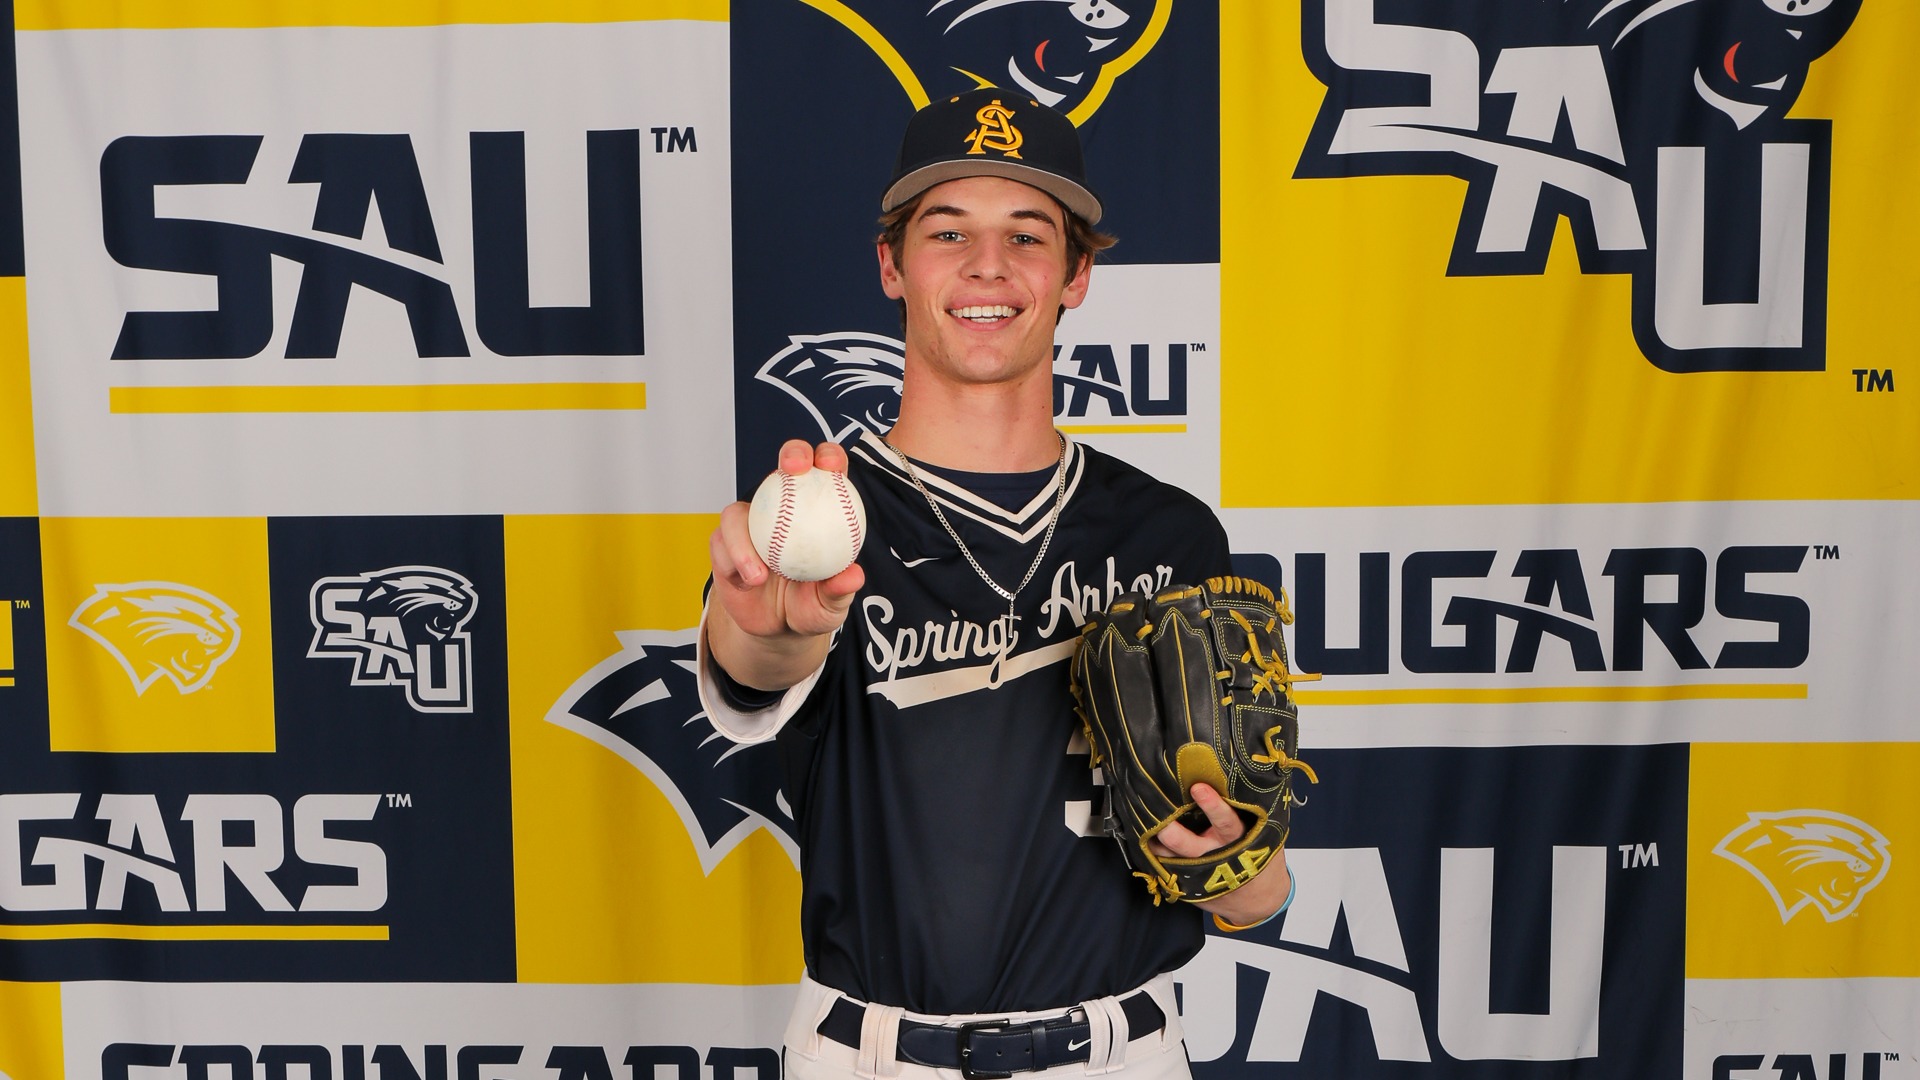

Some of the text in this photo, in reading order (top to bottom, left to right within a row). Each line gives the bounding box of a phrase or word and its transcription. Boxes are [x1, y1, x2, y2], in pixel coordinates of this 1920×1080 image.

[99, 128, 646, 361] SAU
[1052, 343, 1188, 417] AU
[1852, 368, 1895, 393] TM
[321, 588, 461, 701] SAU
[862, 595, 1019, 691] Spring
